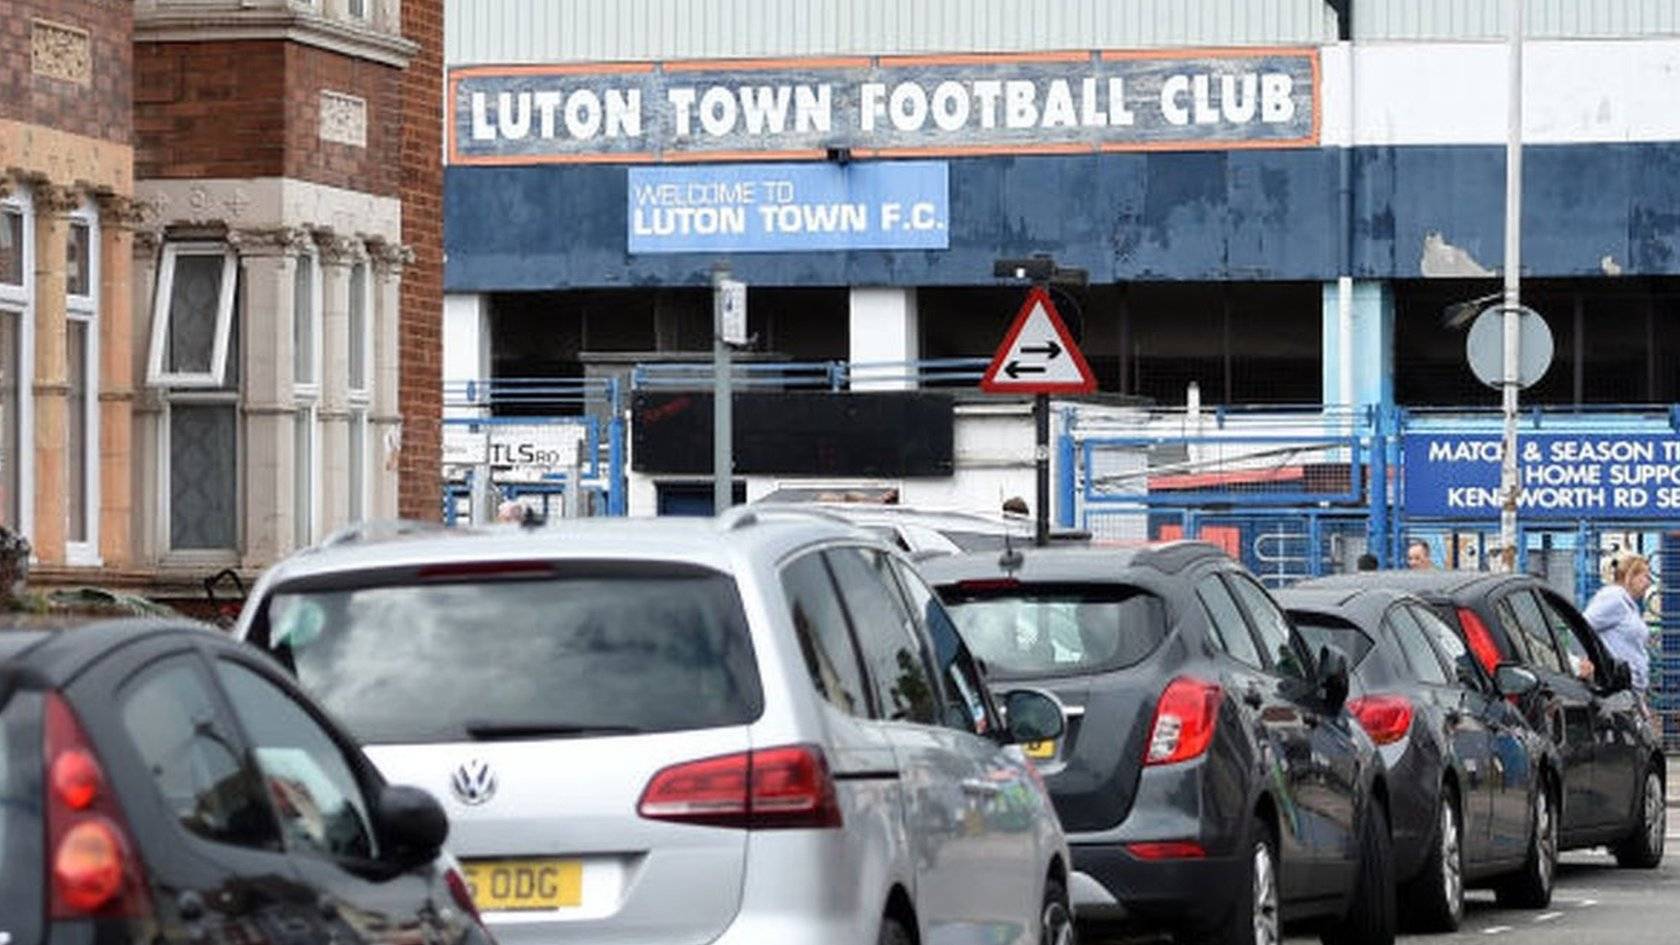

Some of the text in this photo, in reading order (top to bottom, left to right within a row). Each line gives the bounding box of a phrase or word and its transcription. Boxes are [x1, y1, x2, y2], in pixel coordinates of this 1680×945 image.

[471, 73, 1296, 141] LUTON TOWN FOOTBALL CLUB
[635, 180, 795, 207] WELCOME TO
[633, 202, 945, 236] LUTON TOWN F.C.
[1428, 440, 1503, 462] MATC
[1523, 441, 1543, 462] &
[1550, 440, 1654, 462] SEASON
[1525, 464, 1602, 485] HOME
[1614, 487, 1649, 508] RD
[491, 866, 558, 899] ODG
